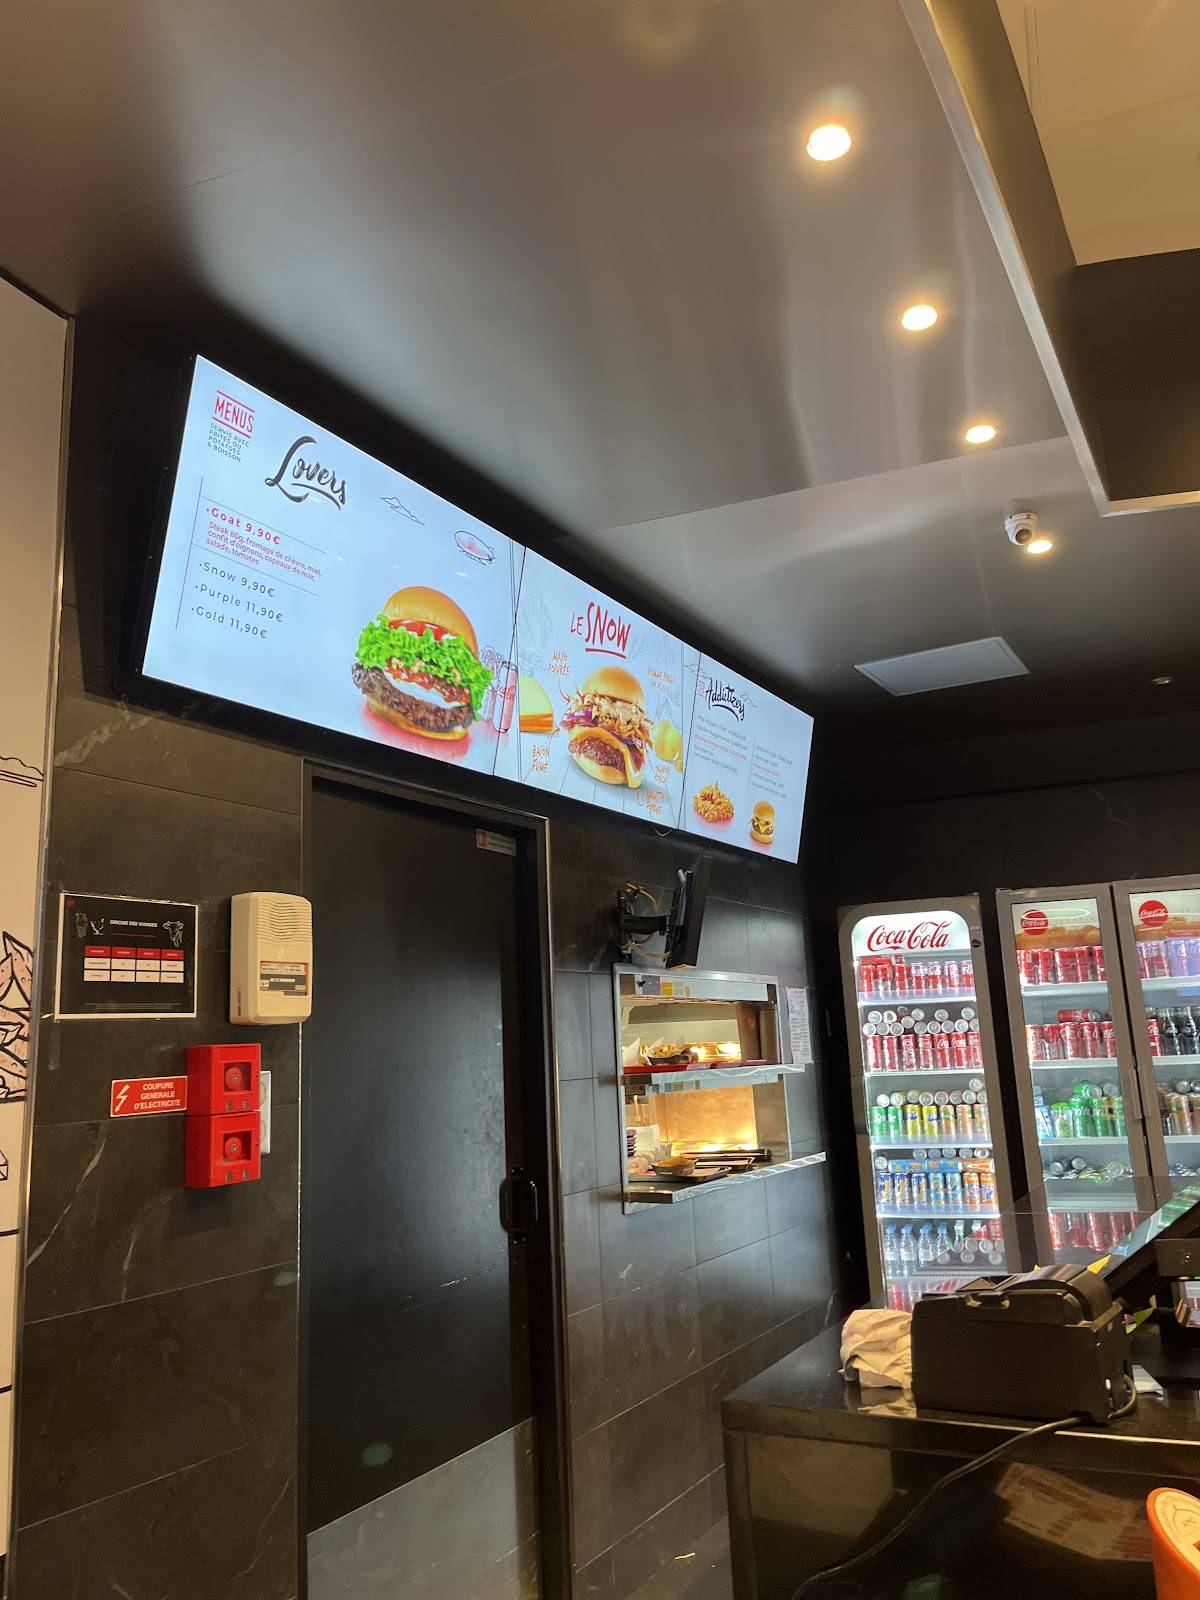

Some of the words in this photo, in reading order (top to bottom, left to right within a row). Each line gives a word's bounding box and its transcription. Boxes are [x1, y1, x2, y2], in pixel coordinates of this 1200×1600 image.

[214, 396, 255, 433] MENUS
[208, 435, 241, 456] POTATOES
[209, 429, 231, 443] FRITES
[232, 441, 242, 449] OU
[210, 423, 233, 437] SERVIS
[234, 436, 250, 448] AVEC
[213, 445, 241, 462] BOISSON
[264, 435, 346, 505] Lovers
[208, 521, 229, 536] Steak
[246, 537, 274, 556] fromage
[275, 549, 284, 559] de
[211, 507, 241, 528] Goat
[245, 522, 280, 545] 9,90€
[208, 530, 229, 544] confit
[264, 555, 291, 571] copeaux
[292, 565, 301, 576] de
[232, 548, 260, 565] tomates
[203, 562, 236, 582] Snow
[241, 577, 275, 597] 9,90€
[200, 583, 241, 607] Purple
[246, 601, 284, 622] 11,90€
[196, 606, 225, 624] Gold
[230, 617, 268, 639] 11,90€
[570, 612, 584, 636] LE
[584, 601, 631, 652] SNOW
[867, 920, 952, 951] Coca-Cola
[140, 1090, 175, 1100] GENERALE
[142, 1081, 174, 1091] COUPURE
